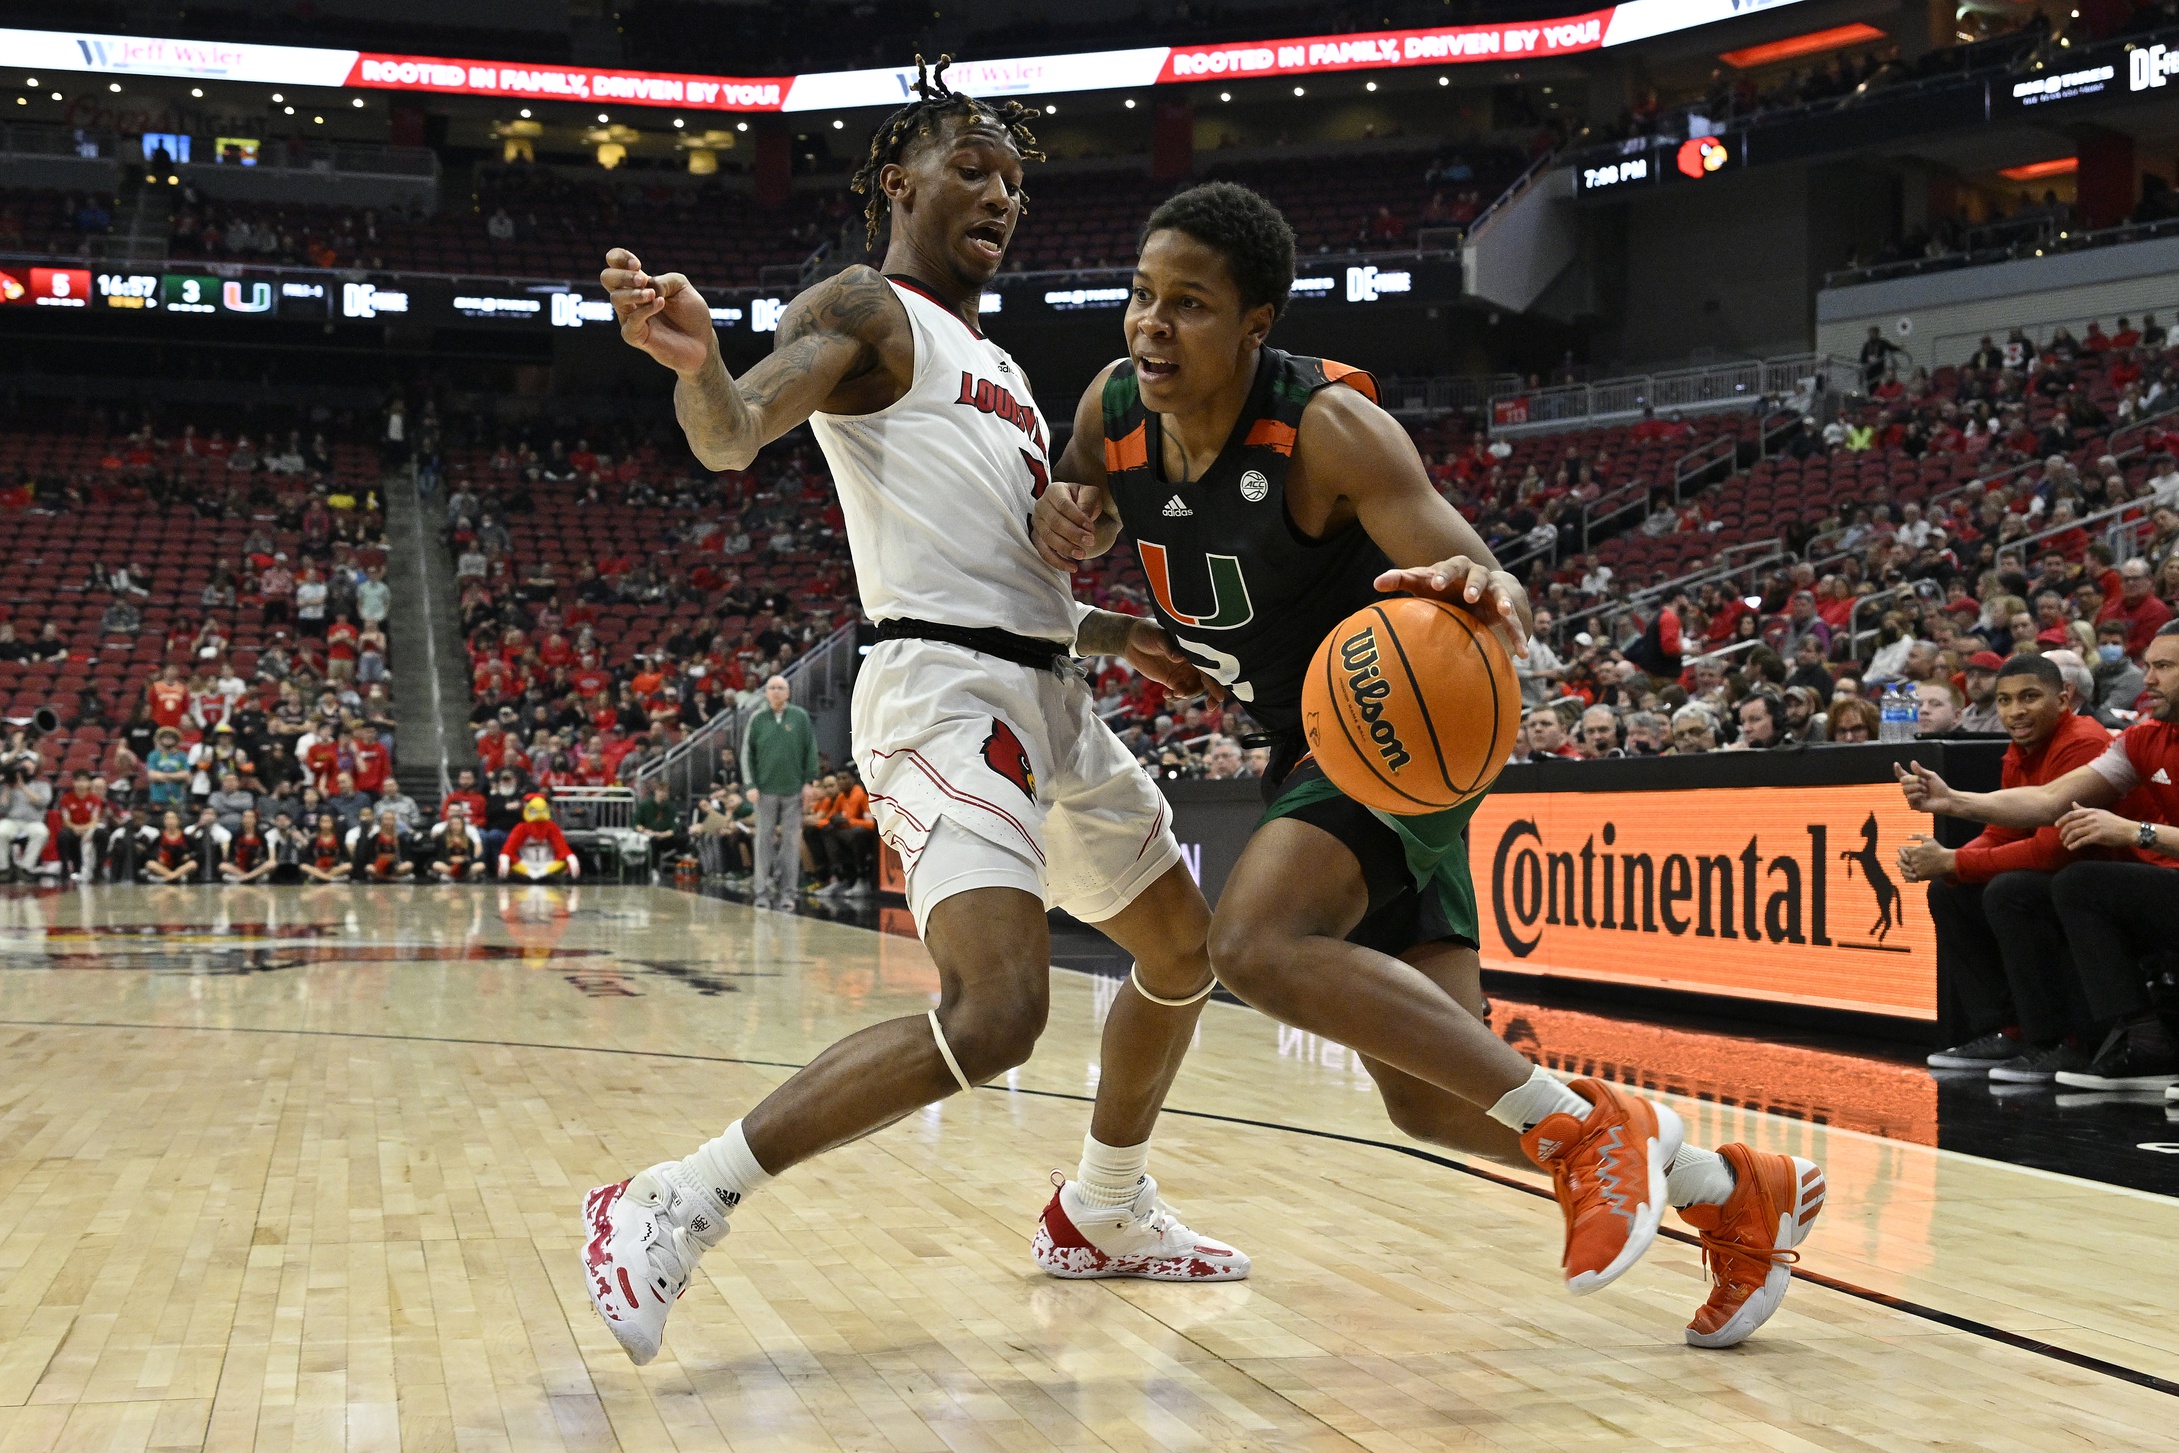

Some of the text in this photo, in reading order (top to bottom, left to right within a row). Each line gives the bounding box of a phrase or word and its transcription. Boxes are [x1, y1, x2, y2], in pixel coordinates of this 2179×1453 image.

[121, 38, 168, 63] Jeff
[174, 45, 244, 70] Wyler
[1173, 19, 1600, 76] ROOTED IN FAMILY, DRIVEN BY YOU!
[361, 60, 780, 106] ROOTED IN FAMILY, DRIVEN BY YOU!
[942, 62, 1043, 89] eff Wyler
[1620, 159, 1647, 182] PM
[52, 273, 71, 298] 5
[97, 274, 157, 297] 16:57
[182, 279, 201, 303] 3
[223, 281, 272, 313] U
[1244, 480, 1265, 488] ACC
[1162, 509, 1194, 517] adidas
[1137, 538, 1254, 630] U
[1340, 625, 1411, 775] Wilson
[1491, 814, 1832, 957] Continental
